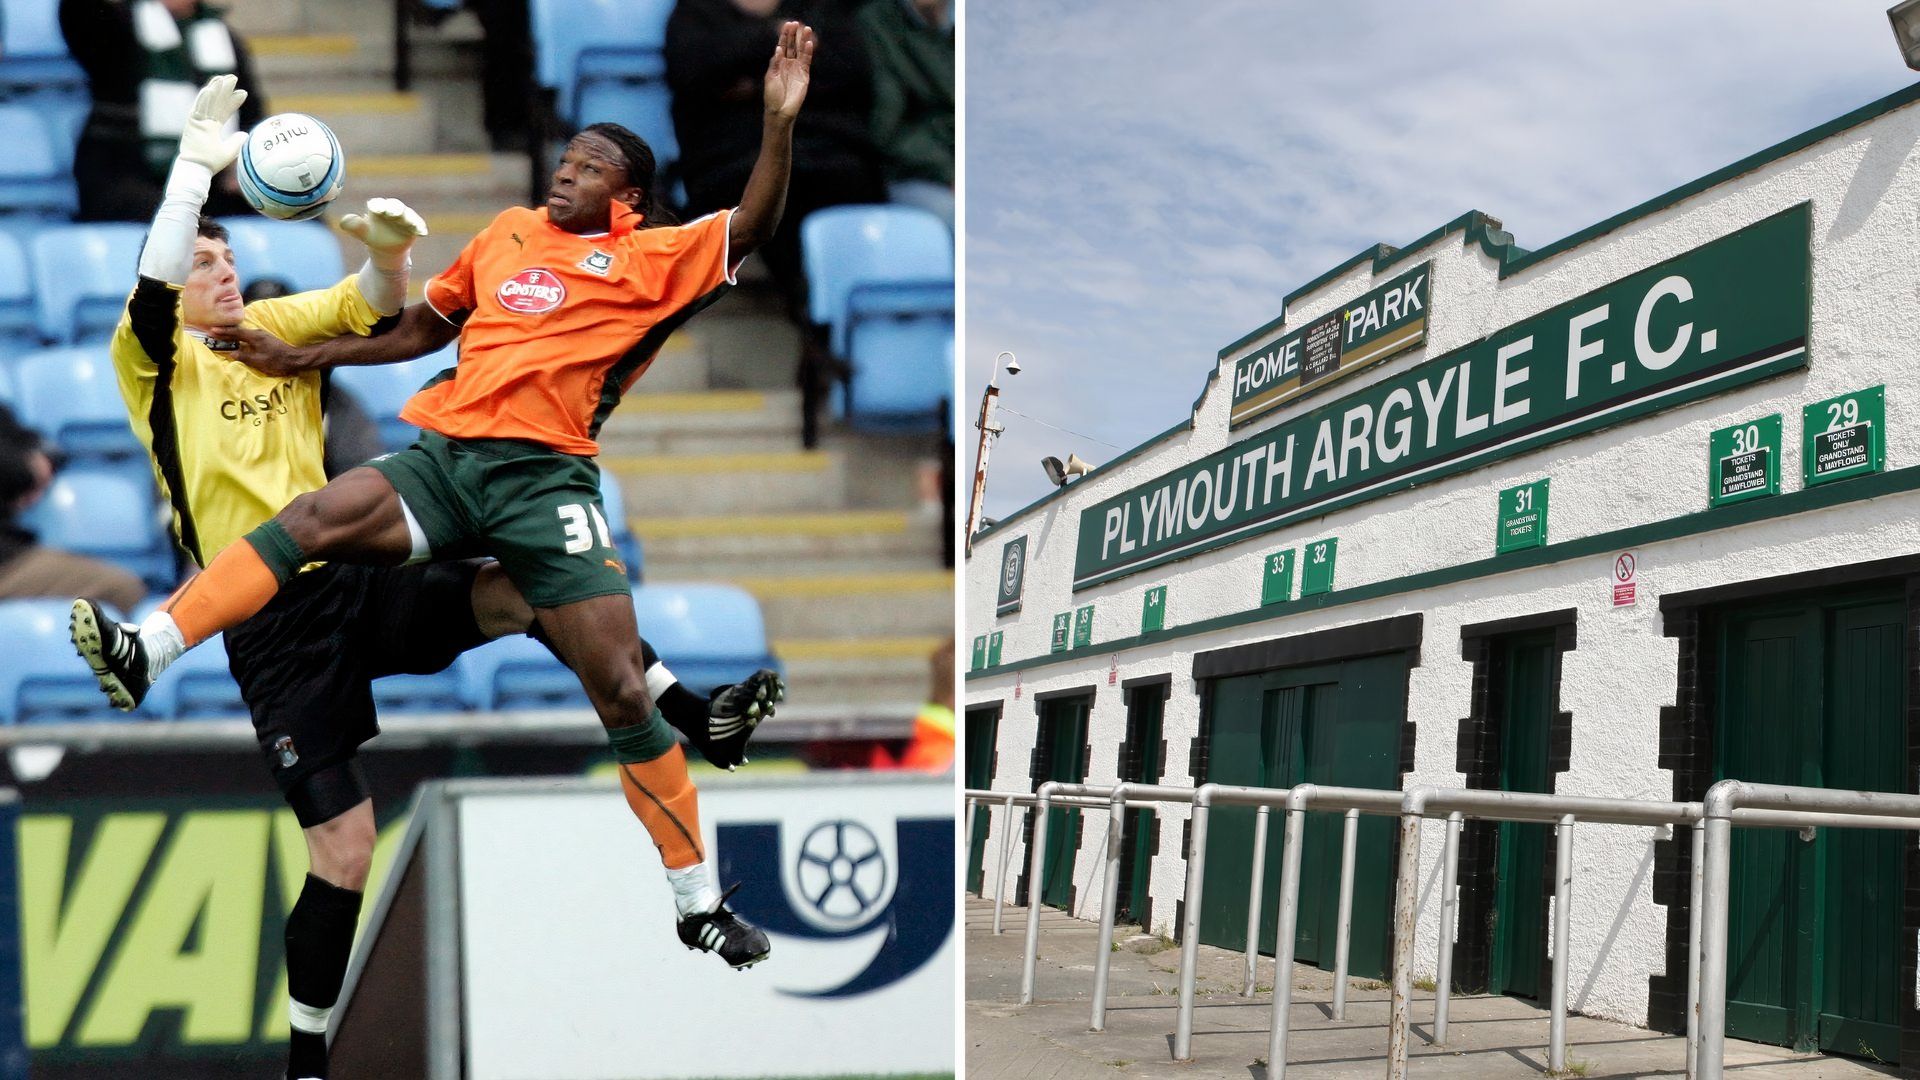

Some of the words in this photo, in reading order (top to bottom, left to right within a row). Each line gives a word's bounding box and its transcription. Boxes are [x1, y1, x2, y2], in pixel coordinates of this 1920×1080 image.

[264, 127, 308, 150] mitre
[1235, 338, 1300, 398] HOME
[1347, 274, 1425, 343] PARK
[1101, 434, 1295, 561] PLYMOUTH
[1304, 335, 1533, 490] ARGYLE
[1566, 275, 1717, 401] F.C.
[1826, 398, 1859, 432] 29
[1731, 425, 1759, 456] 30
[1827, 429, 1855, 443] TICKETS
[1832, 438, 1850, 450] ONLY
[1731, 453, 1756, 466] TICKETS
[1819, 446, 1864, 462] GRANDSTAND
[1825, 454, 1866, 471] MAYFLOWER
[1723, 469, 1764, 485] GRANDSTAND
[1735, 463, 1751, 474] ONLY
[1729, 477, 1765, 493] MAYFLOWER
[1515, 487, 1533, 513] 31
[557, 503, 611, 554] 31
[1506, 513, 1538, 528] GRANDSTAND
[1510, 525, 1532, 536] TICKETS
[1313, 543, 1327, 564] 32
[1272, 554, 1285, 575] 33
[1149, 589, 1159, 607] 34
